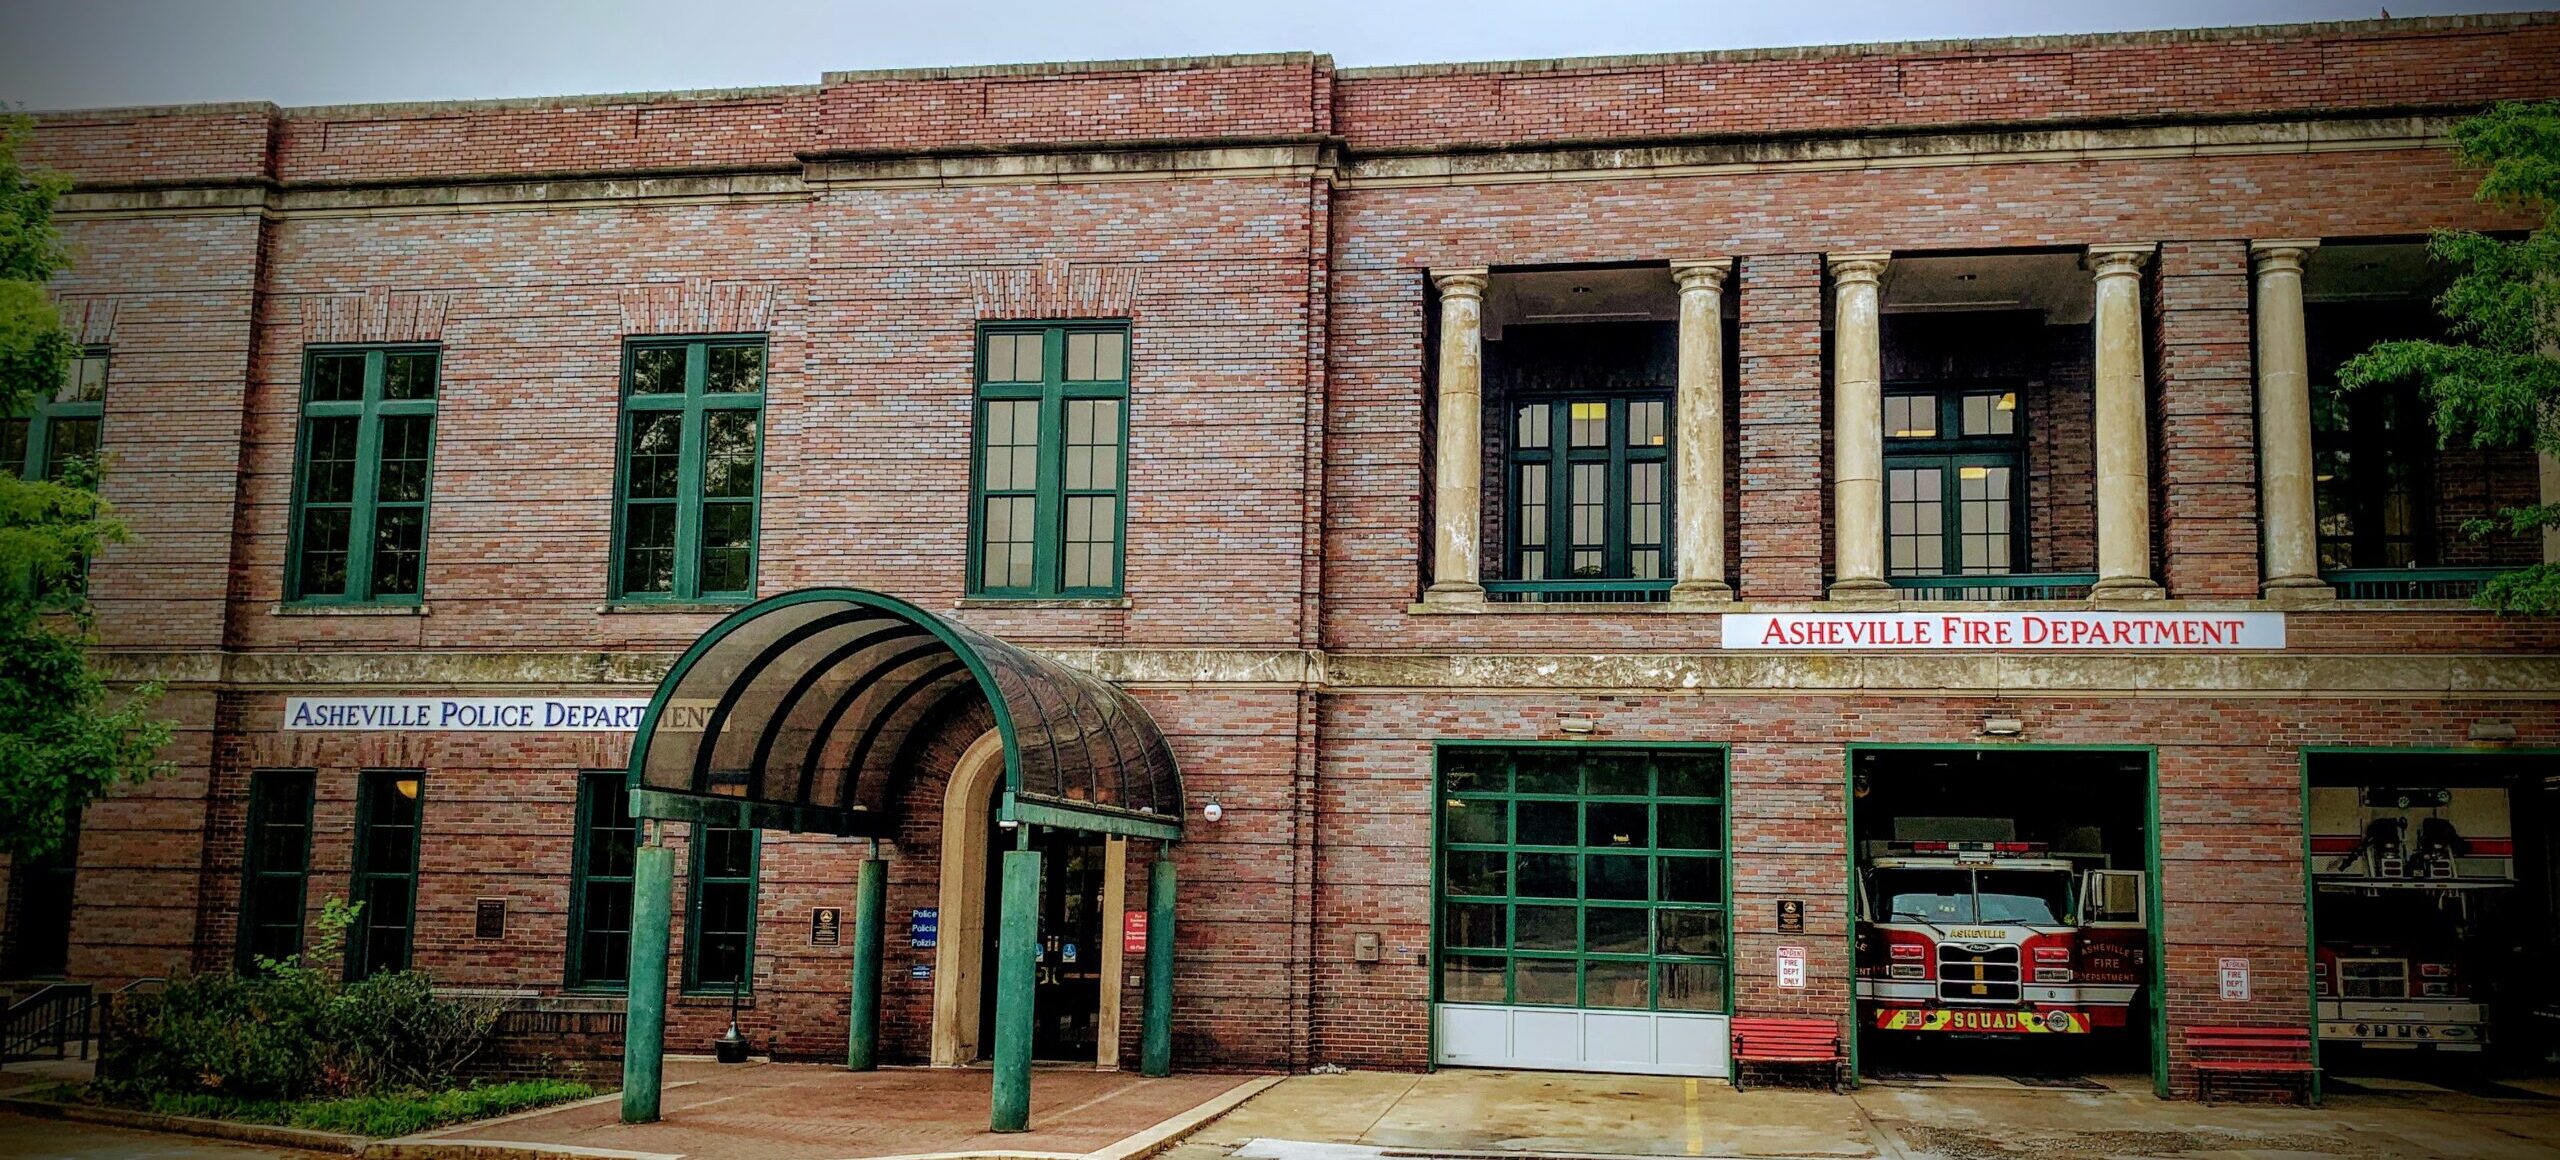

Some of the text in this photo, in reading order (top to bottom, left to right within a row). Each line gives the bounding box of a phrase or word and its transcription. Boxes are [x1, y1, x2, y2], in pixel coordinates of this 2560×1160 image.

[1761, 616, 2245, 645] ASHEVILLE FIRE DEPARTMENT
[292, 701, 431, 727] ASHEVILLE
[440, 701, 534, 727] POLICE
[912, 909, 938, 918] Police
[1951, 929, 2007, 939] ASHEVILLE
[911, 939, 936, 947] Polizia
[2081, 943, 2130, 958] ASHEVILLE
[2094, 958, 2120, 969] FIRE
[1971, 956, 1988, 995] 1
[1954, 1012, 2017, 1029] SQUAD
